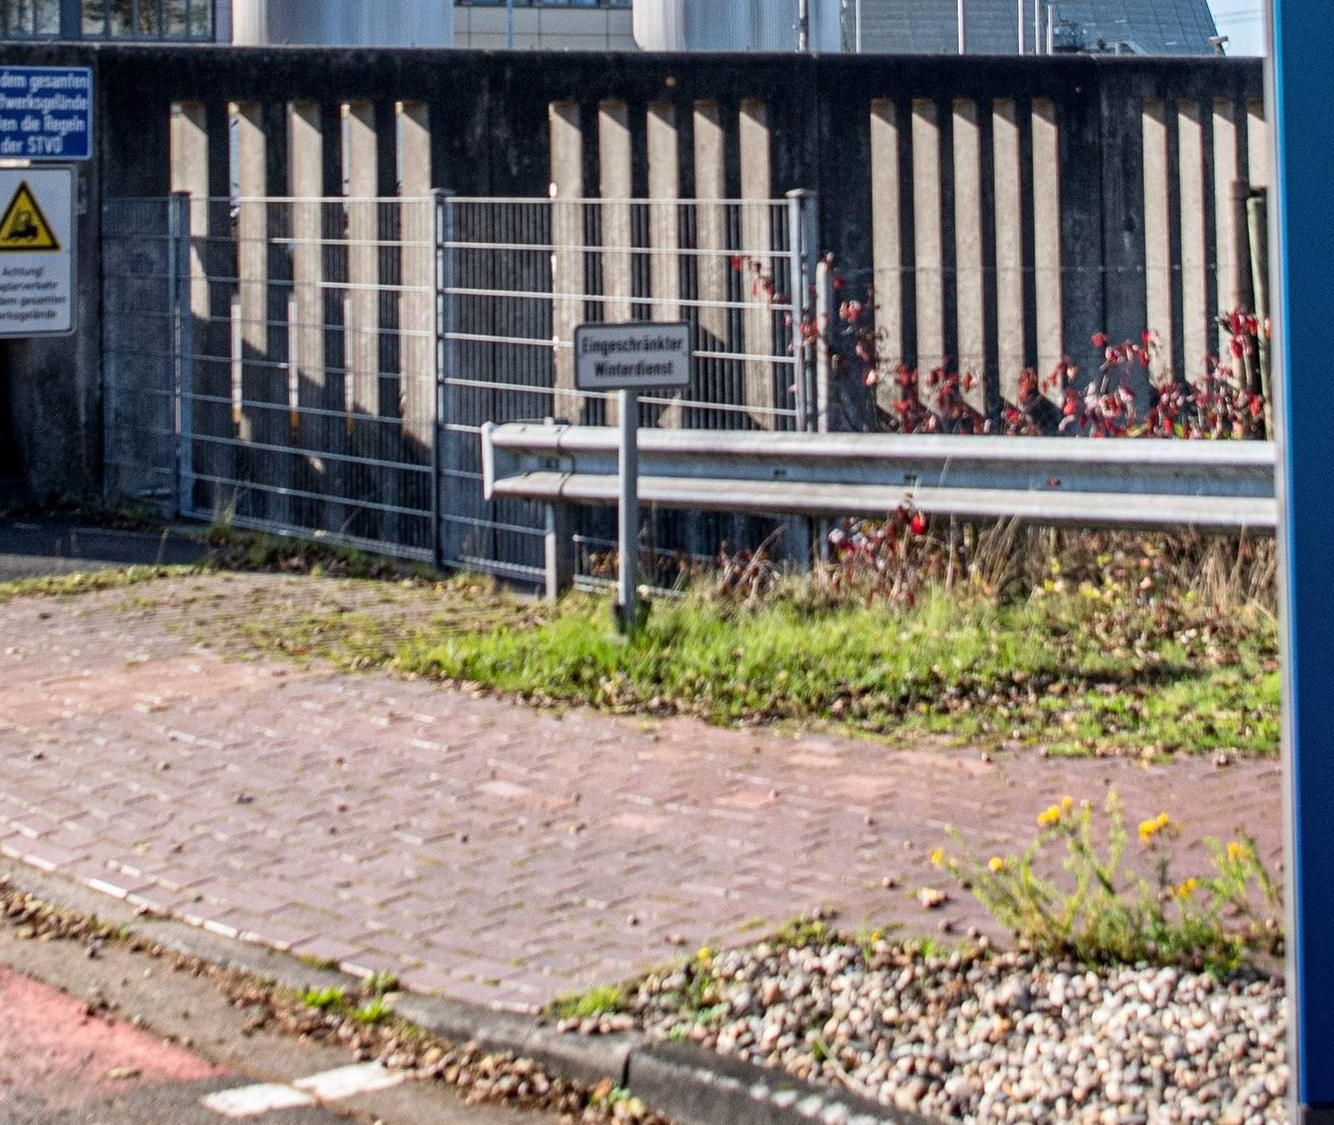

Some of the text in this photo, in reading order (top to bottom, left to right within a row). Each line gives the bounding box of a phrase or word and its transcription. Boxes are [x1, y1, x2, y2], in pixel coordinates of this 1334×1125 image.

[0, 71, 27, 88] dem
[20, 115, 41, 132] die
[0, 135, 23, 154] der
[581, 336, 683, 356] Eingeschränkter
[594, 360, 673, 377] Winterdienst
